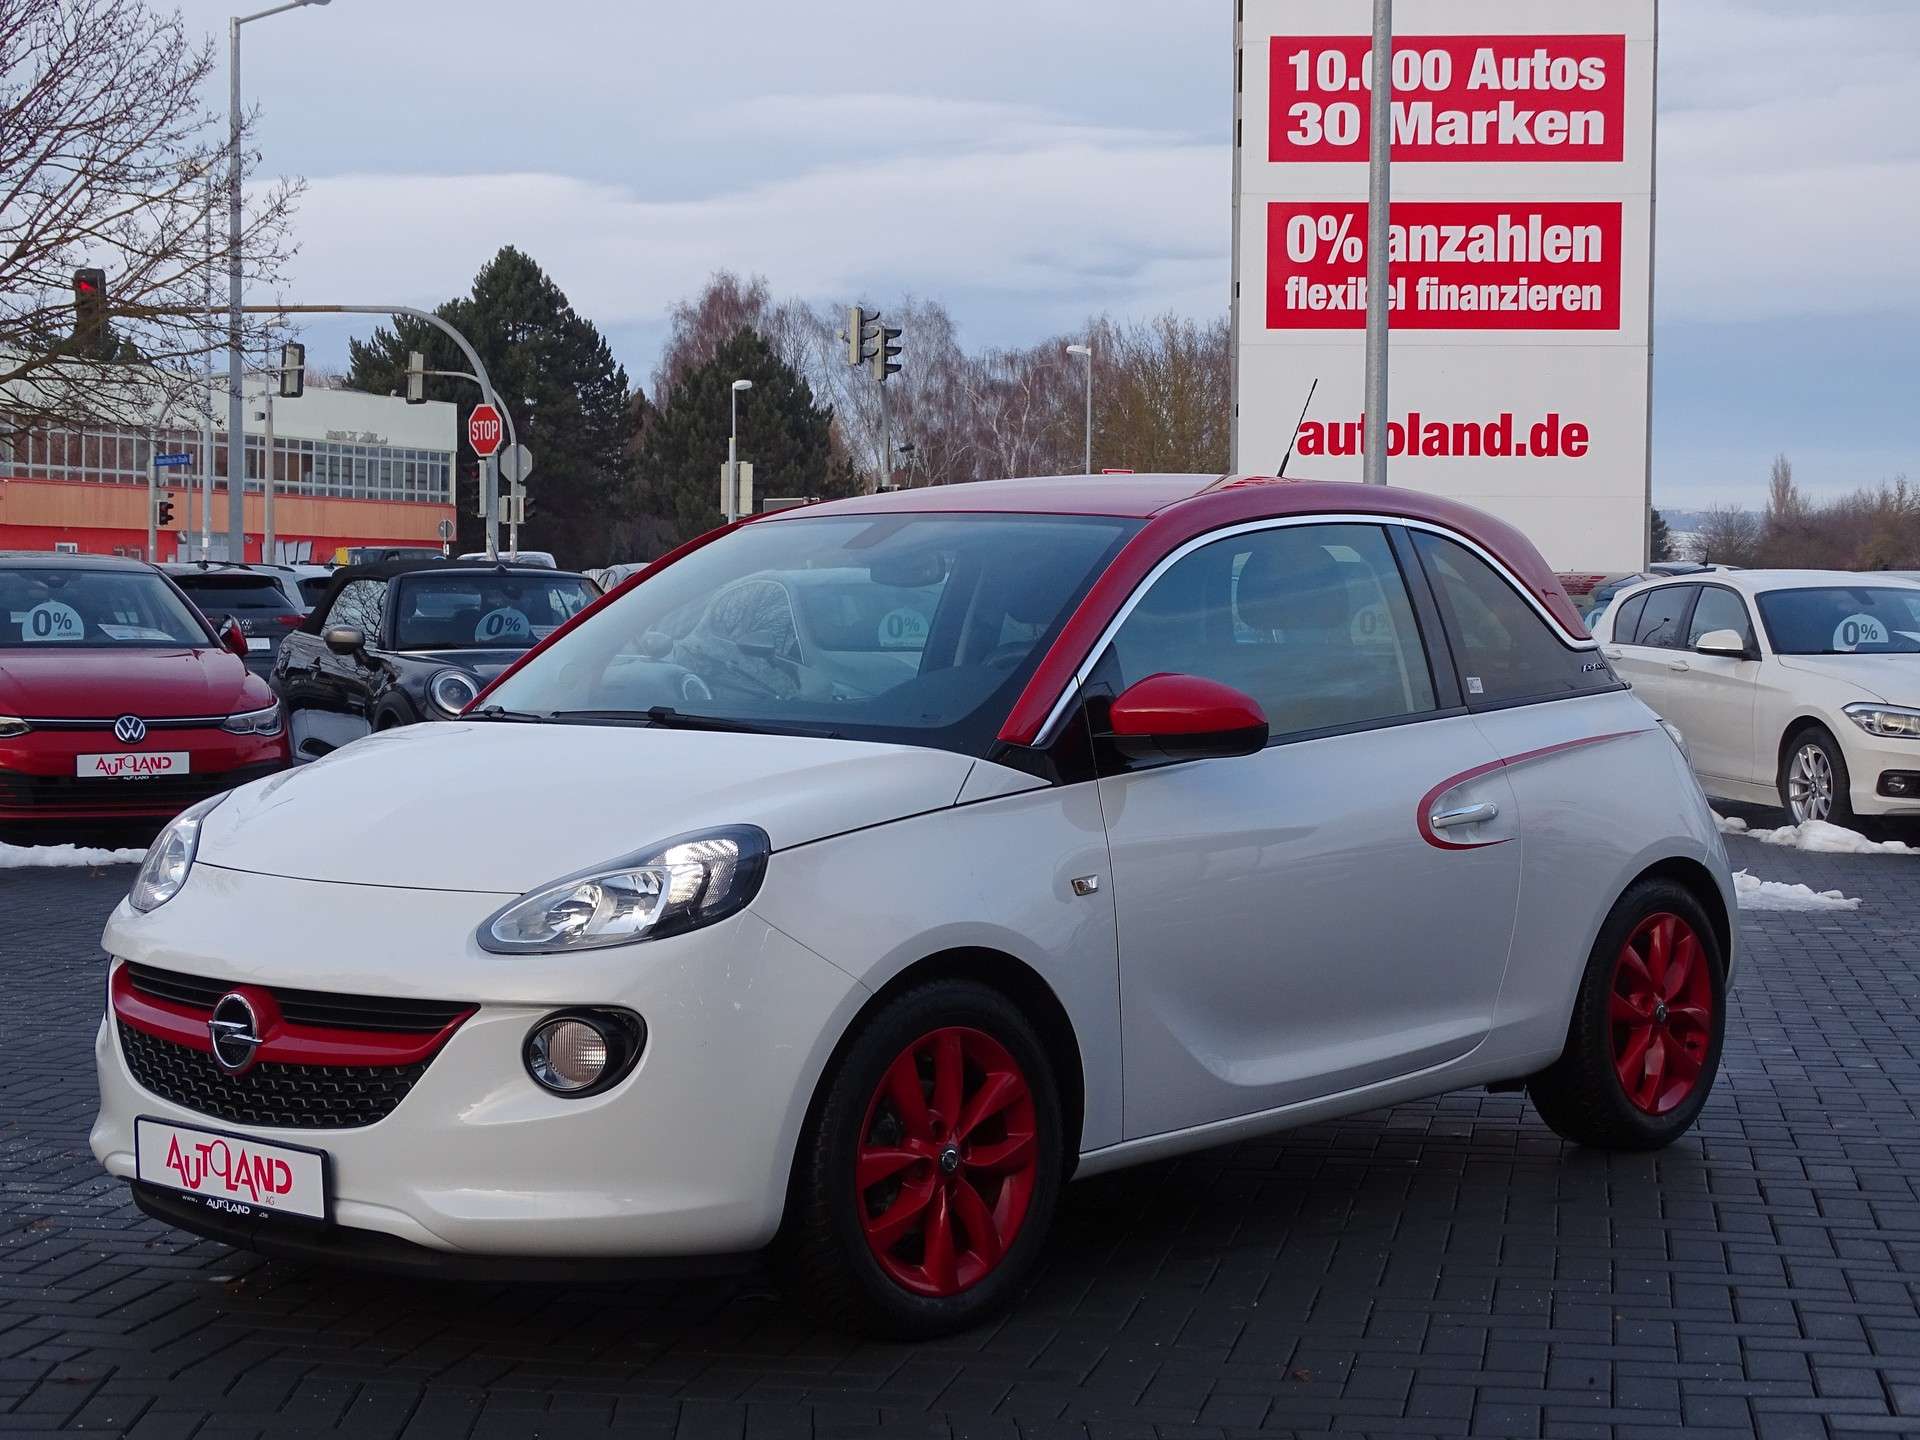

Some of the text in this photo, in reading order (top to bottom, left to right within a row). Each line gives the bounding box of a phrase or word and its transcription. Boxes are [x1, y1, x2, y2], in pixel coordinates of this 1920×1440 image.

[1466, 47, 1607, 91] Autos
[1287, 100, 1605, 146] 30 Marken
[1286, 213, 1602, 264] 0% anzahlen
[1415, 276, 1602, 311] finanzieren
[472, 419, 498, 441] STOP
[33, 610, 73, 636] 0%
[487, 614, 520, 635] 0%
[1843, 621, 1878, 646] 0%
